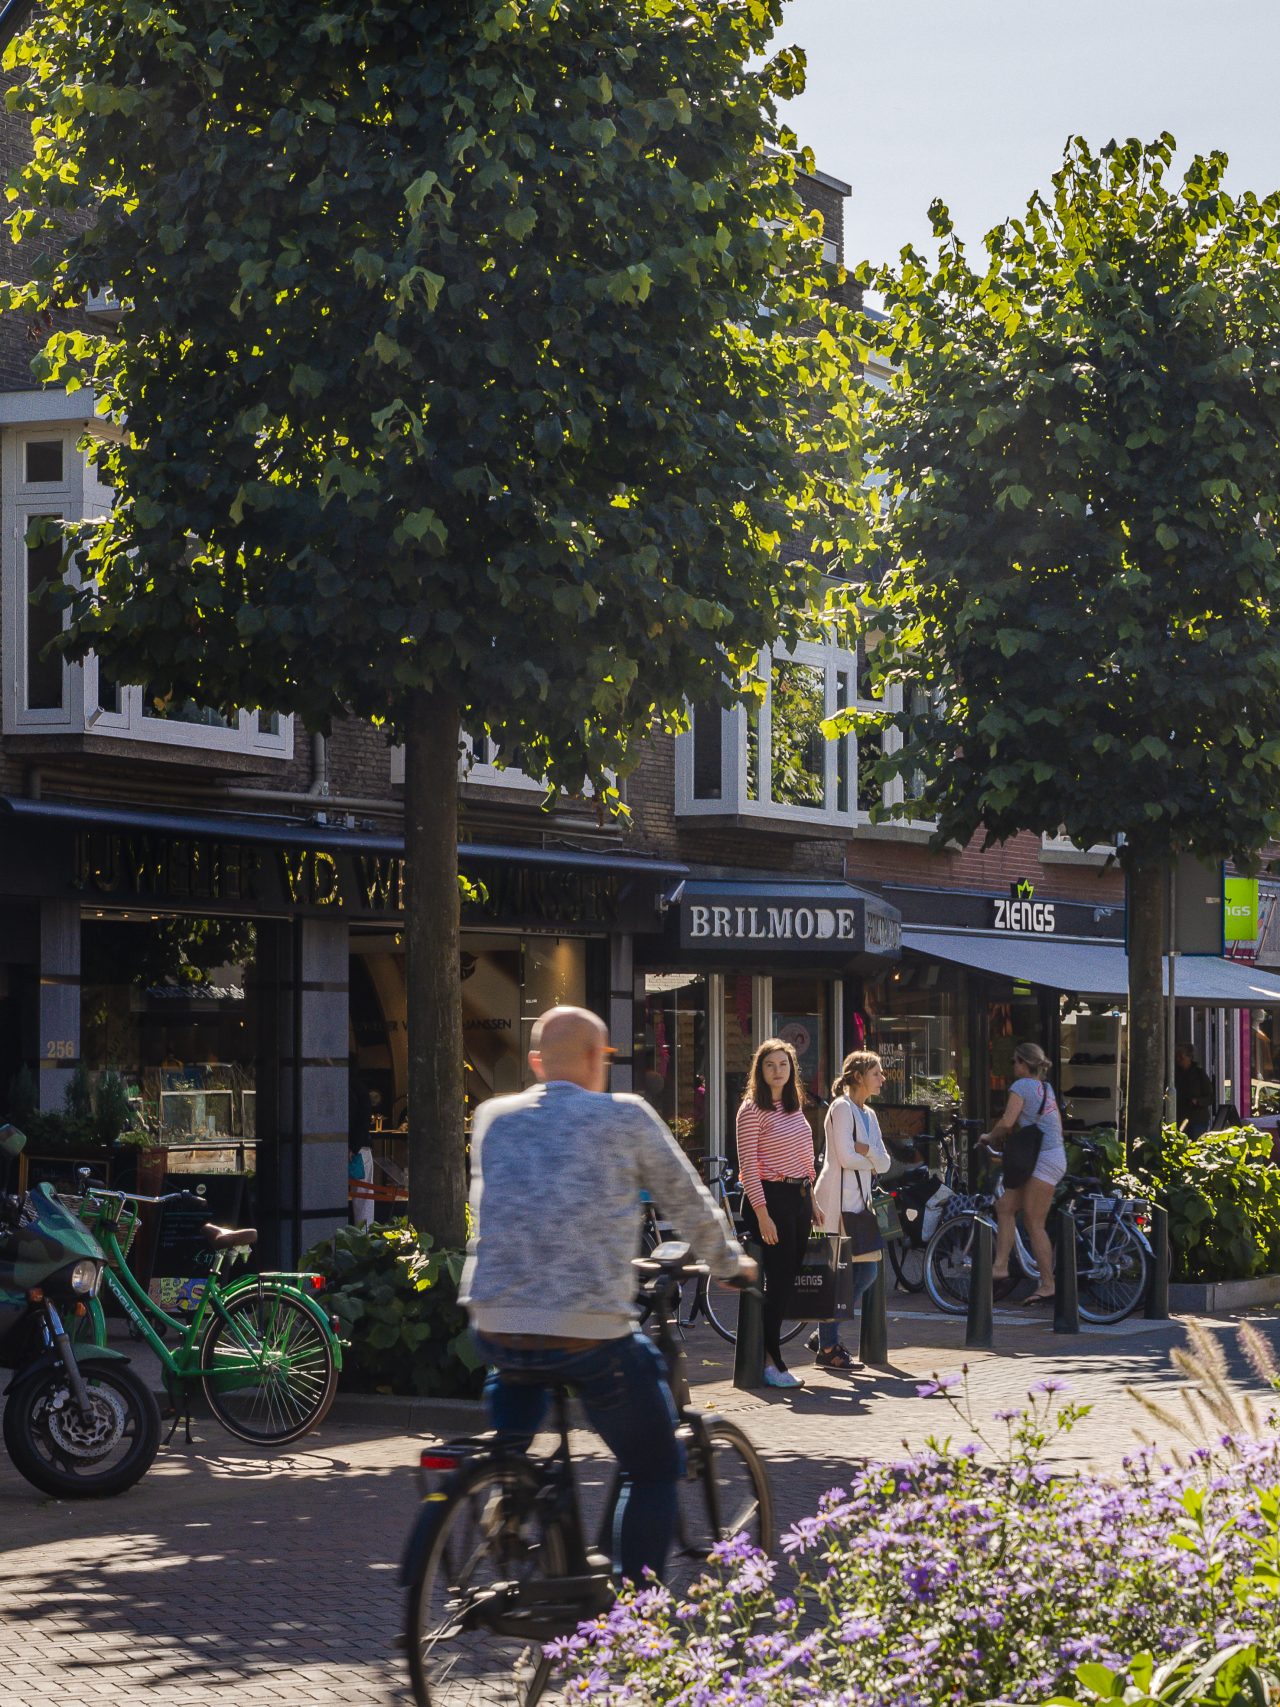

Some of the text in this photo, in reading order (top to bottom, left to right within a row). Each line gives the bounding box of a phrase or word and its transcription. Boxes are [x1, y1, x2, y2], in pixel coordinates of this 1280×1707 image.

[1225, 905, 1251, 917] NGS
[690, 905, 855, 940] BRILMODE
[47, 1040, 74, 1059] 256
[879, 1043, 895, 1054] NEXT
[108, 1278, 139, 1323] VOGUE
